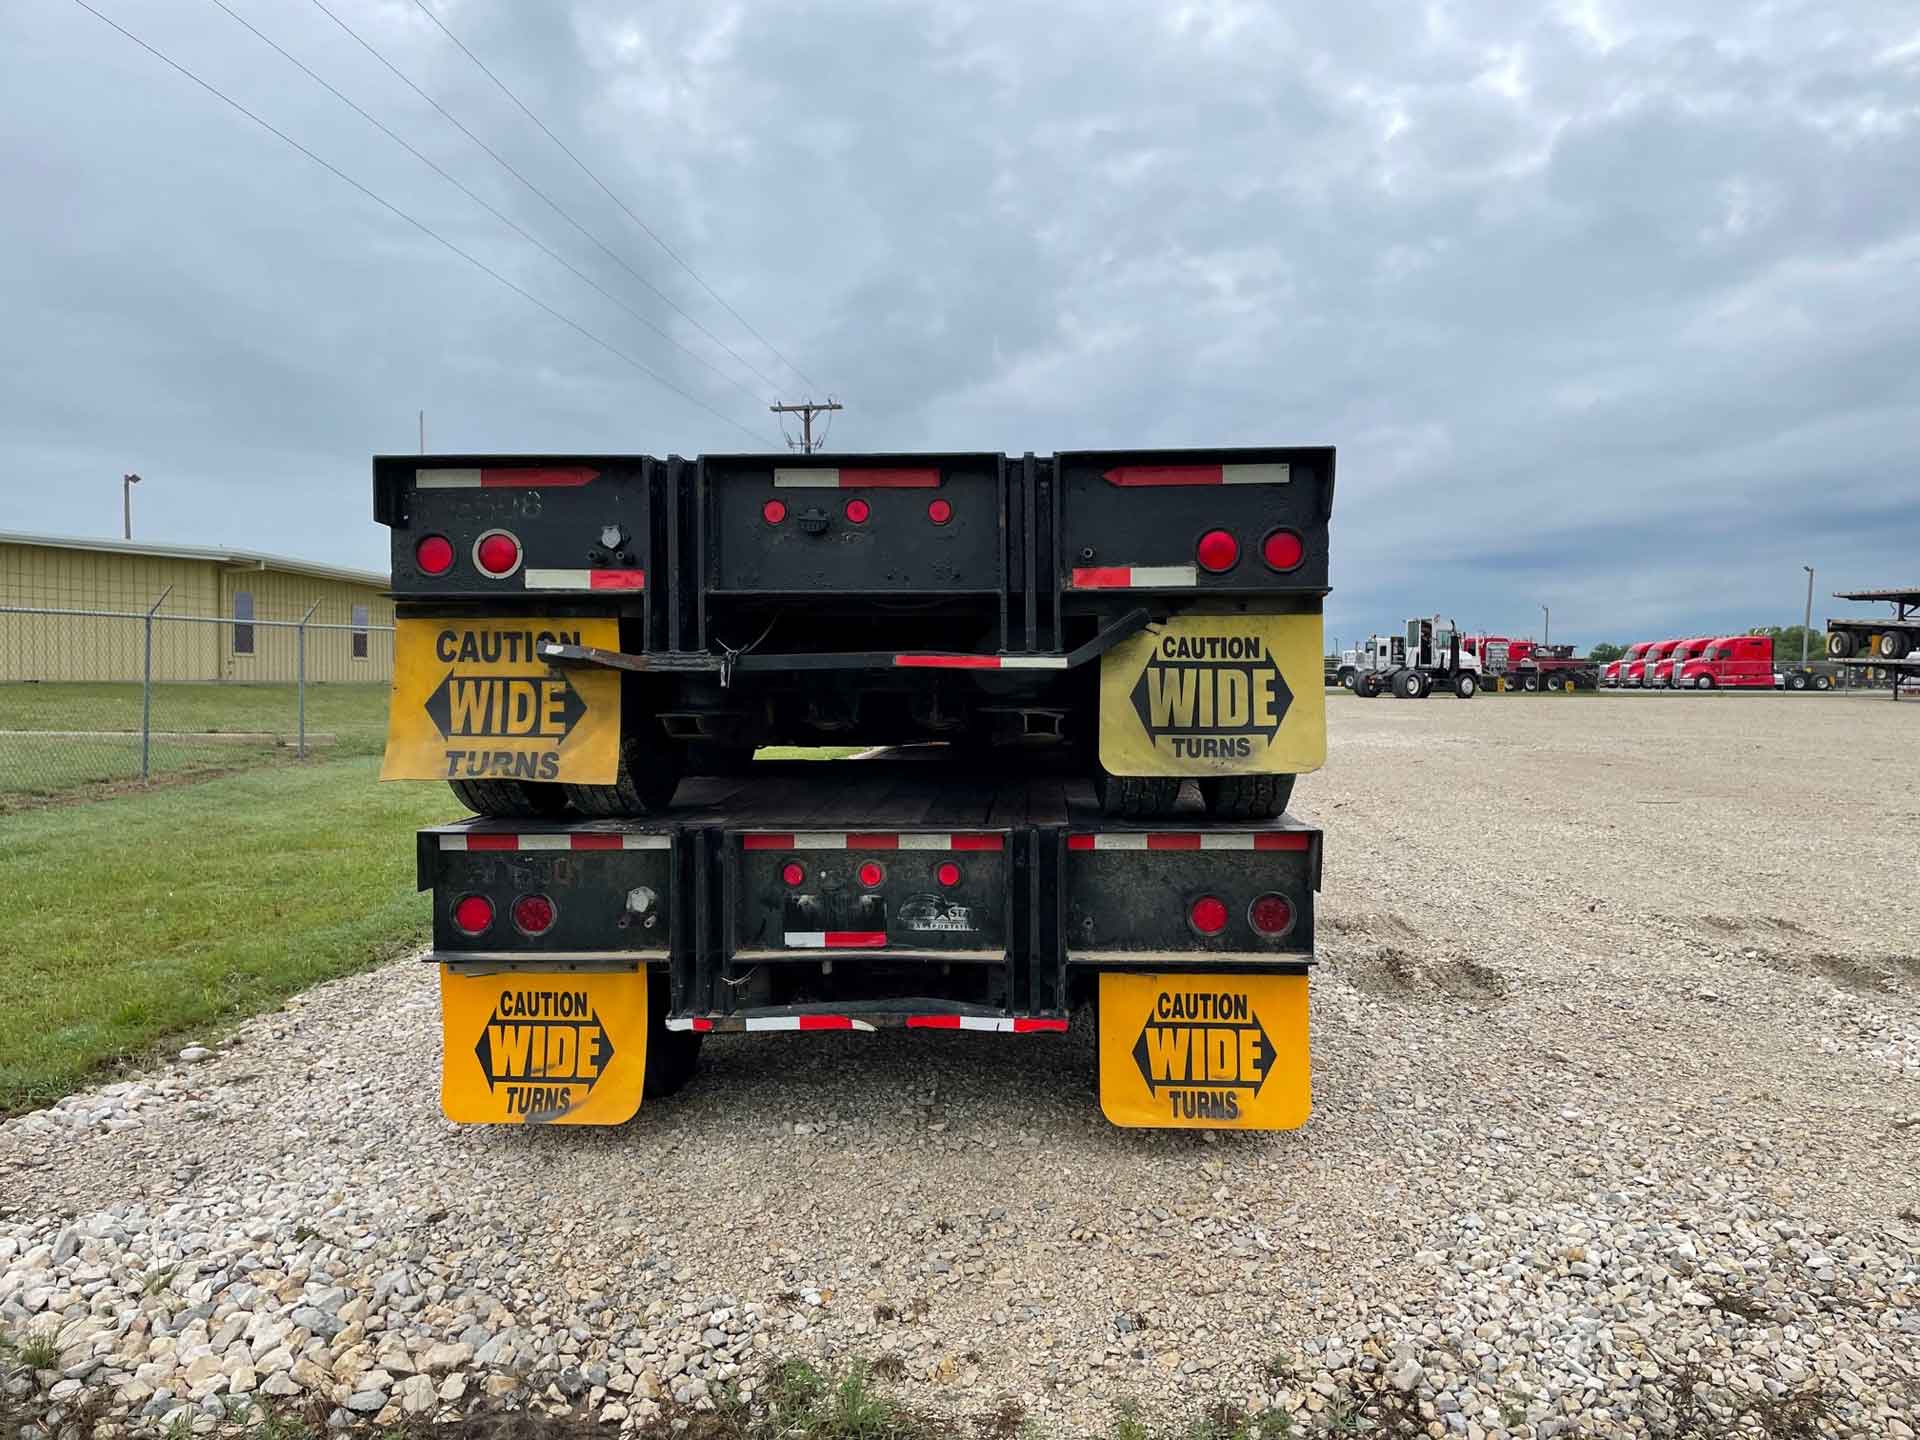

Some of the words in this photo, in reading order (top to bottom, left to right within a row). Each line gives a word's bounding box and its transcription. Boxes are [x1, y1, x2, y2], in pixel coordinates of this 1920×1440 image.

[1162, 637, 1260, 658] CAUTION
[449, 680, 566, 734] WIDE
[1147, 668, 1278, 727] WIDE
[1173, 738, 1251, 758] TURNS
[446, 751, 560, 780] TURNS
[501, 991, 588, 1017] CAUTION
[1157, 993, 1248, 1020] CAUTION
[488, 1025, 601, 1077] WIDE
[1145, 1029, 1263, 1081] WIDE
[506, 1087, 570, 1114] TURNS
[1169, 1090, 1239, 1120] TURNS
